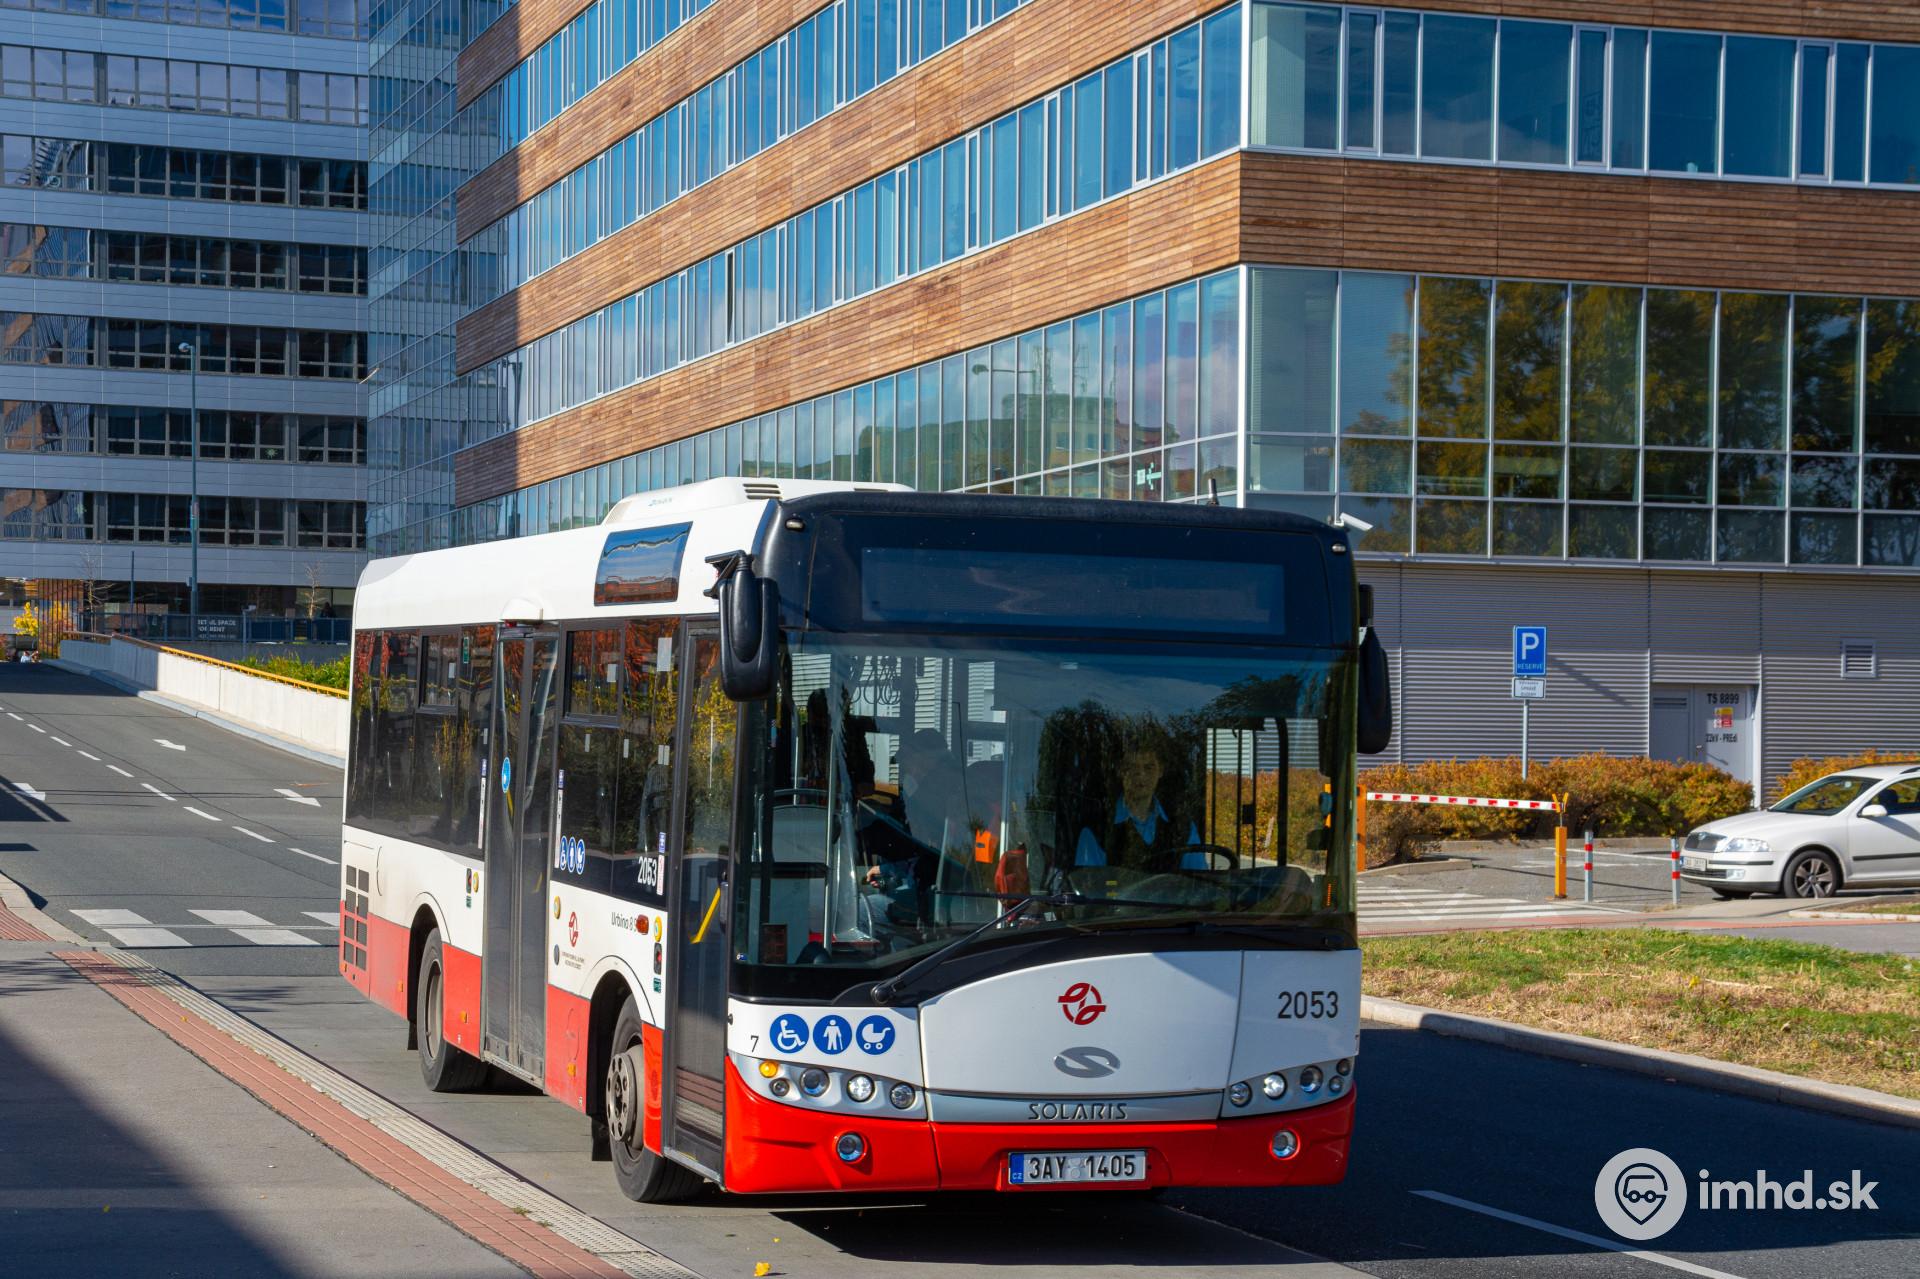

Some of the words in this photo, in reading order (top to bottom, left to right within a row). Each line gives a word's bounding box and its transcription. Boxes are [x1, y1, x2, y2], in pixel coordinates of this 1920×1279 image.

[1521, 632, 1540, 660] P
[1707, 693, 1718, 704] TS
[1719, 693, 1740, 704] 8899
[637, 855, 658, 887] 2053
[611, 911, 629, 931] Urbino
[1277, 990, 1339, 1019] 2053
[750, 1035, 759, 1052] 7
[1028, 1102, 1128, 1120] SOLARIS
[1012, 1172, 1023, 1180] CZ
[1029, 1156, 1066, 1179] 3AY
[1085, 1154, 1137, 1178] 1405
